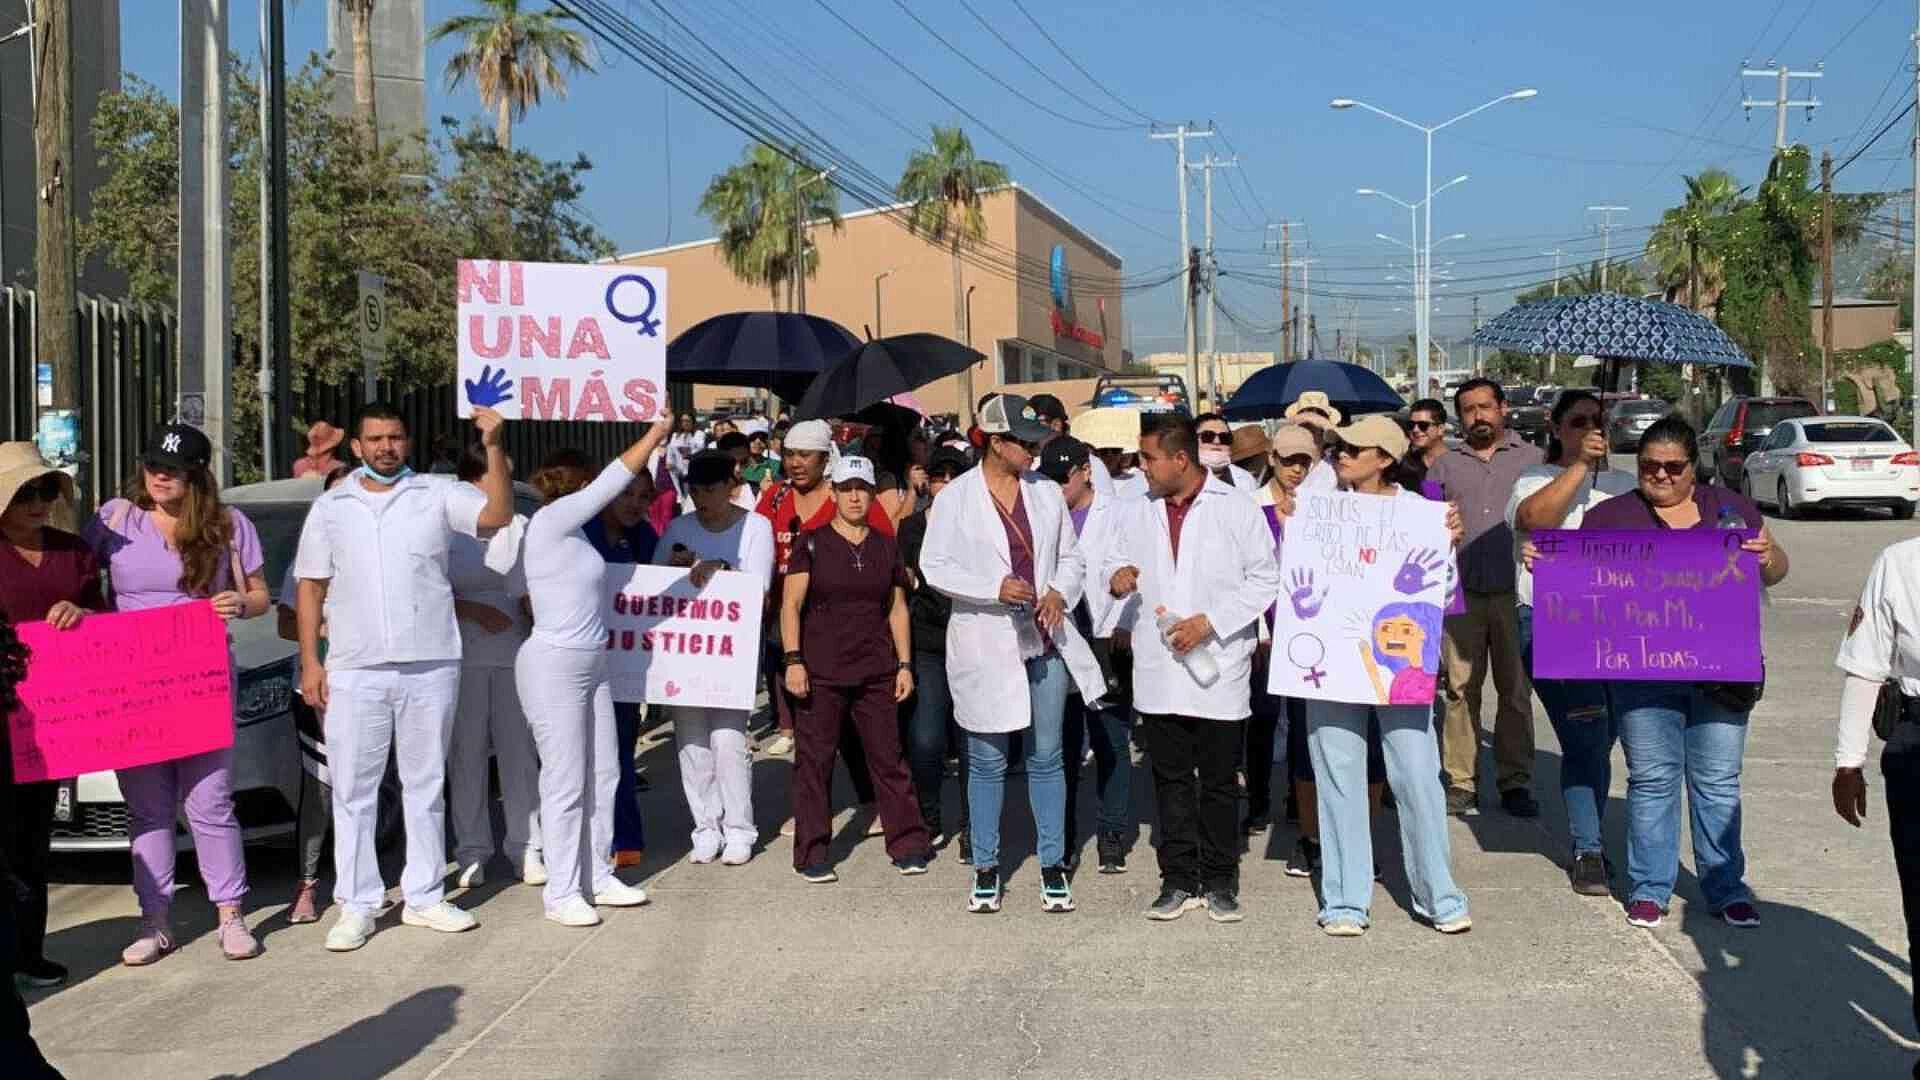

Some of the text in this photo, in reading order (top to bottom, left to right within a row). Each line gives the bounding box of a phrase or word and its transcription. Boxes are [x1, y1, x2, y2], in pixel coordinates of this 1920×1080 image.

[458, 260, 524, 306] NI
[469, 314, 611, 360] UNA
[520, 369, 658, 421] MÁS
[162, 433, 182, 453] NY
[1359, 548, 1376, 565] NO
[614, 592, 742, 622] QUEREMOS
[606, 629, 734, 657] JUSTICIA
